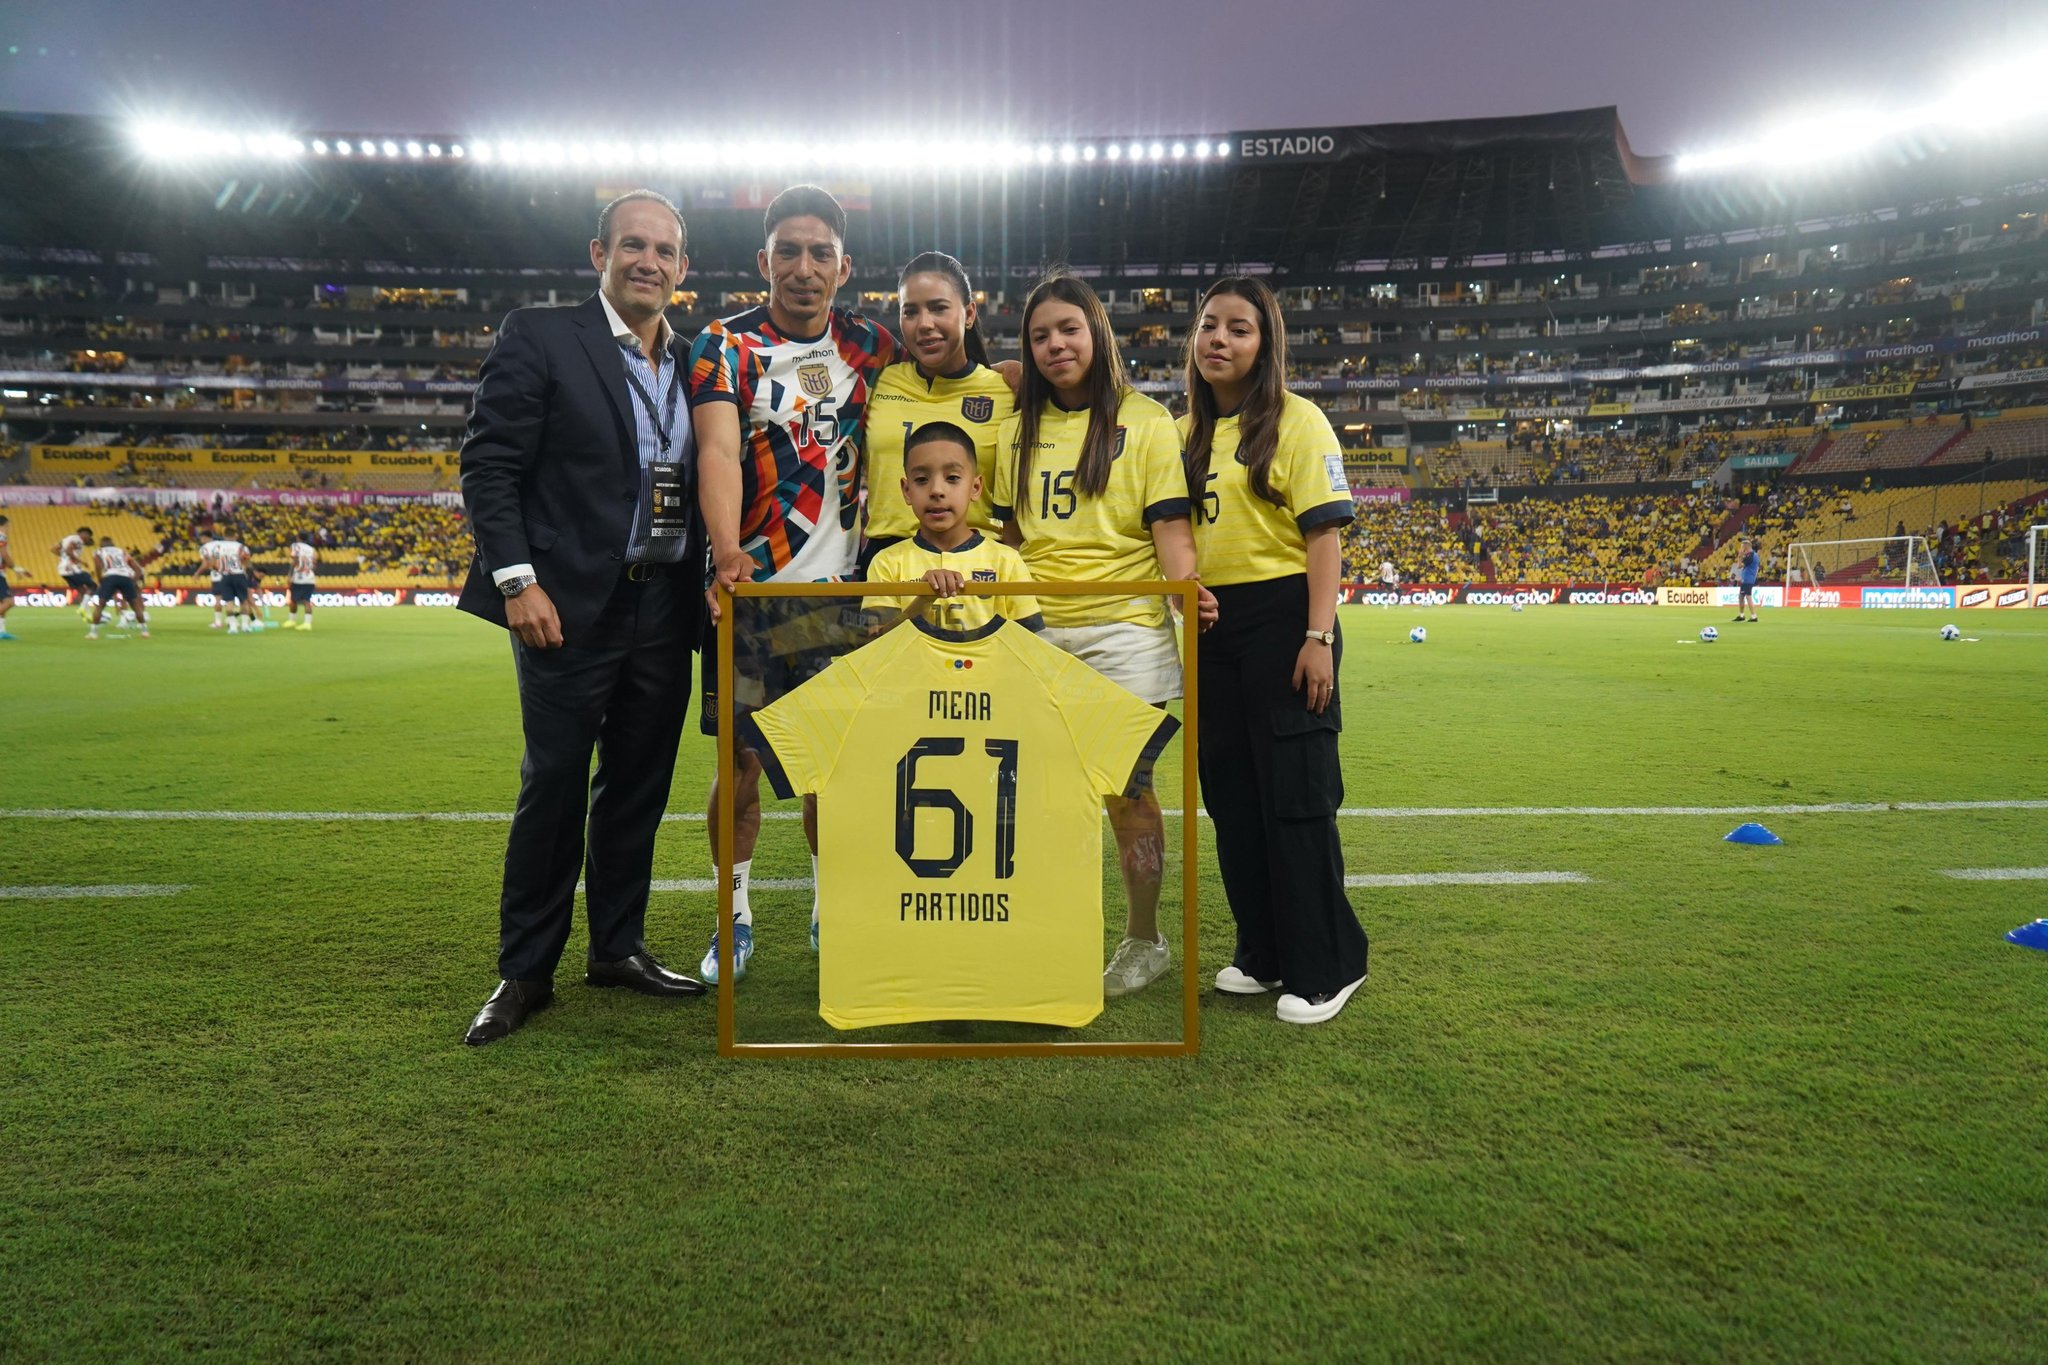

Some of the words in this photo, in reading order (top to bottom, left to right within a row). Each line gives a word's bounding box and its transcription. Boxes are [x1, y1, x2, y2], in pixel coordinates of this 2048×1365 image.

[1241, 135, 1334, 157] ESTADIO
[1967, 328, 2040, 348] marathon
[1866, 342, 1934, 359] marathon
[1769, 352, 1834, 367] marathon
[266, 378, 322, 389] marathon
[348, 380, 404, 391] marathon
[1346, 378, 1400, 389] marathon
[1425, 376, 1480, 387] marathon
[1817, 383, 1909, 399] TELCONET.NET
[1509, 406, 1586, 418] TELCONET.NET
[800, 396, 839, 447] 15
[43, 449, 111, 460] Ecuabet
[126, 450, 193, 462] Ecuabet
[212, 451, 277, 463] Ecuabet
[371, 453, 433, 465] Ecuabet
[1342, 452, 1393, 462] cuabet
[1744, 456, 1780, 466] SALIDA
[1040, 470, 1077, 519] 15
[1466, 591, 1502, 605] FOGO
[1569, 591, 1605, 605] FOGO
[1607, 594, 1620, 604] DE
[1667, 590, 1709, 605] Ecuabet
[1800, 587, 1840, 608] Betano
[1864, 588, 1951, 608] marathon
[929, 690, 991, 721] MENA
[895, 737, 1019, 879] 61
[900, 892, 1009, 922] PARTIDOS
